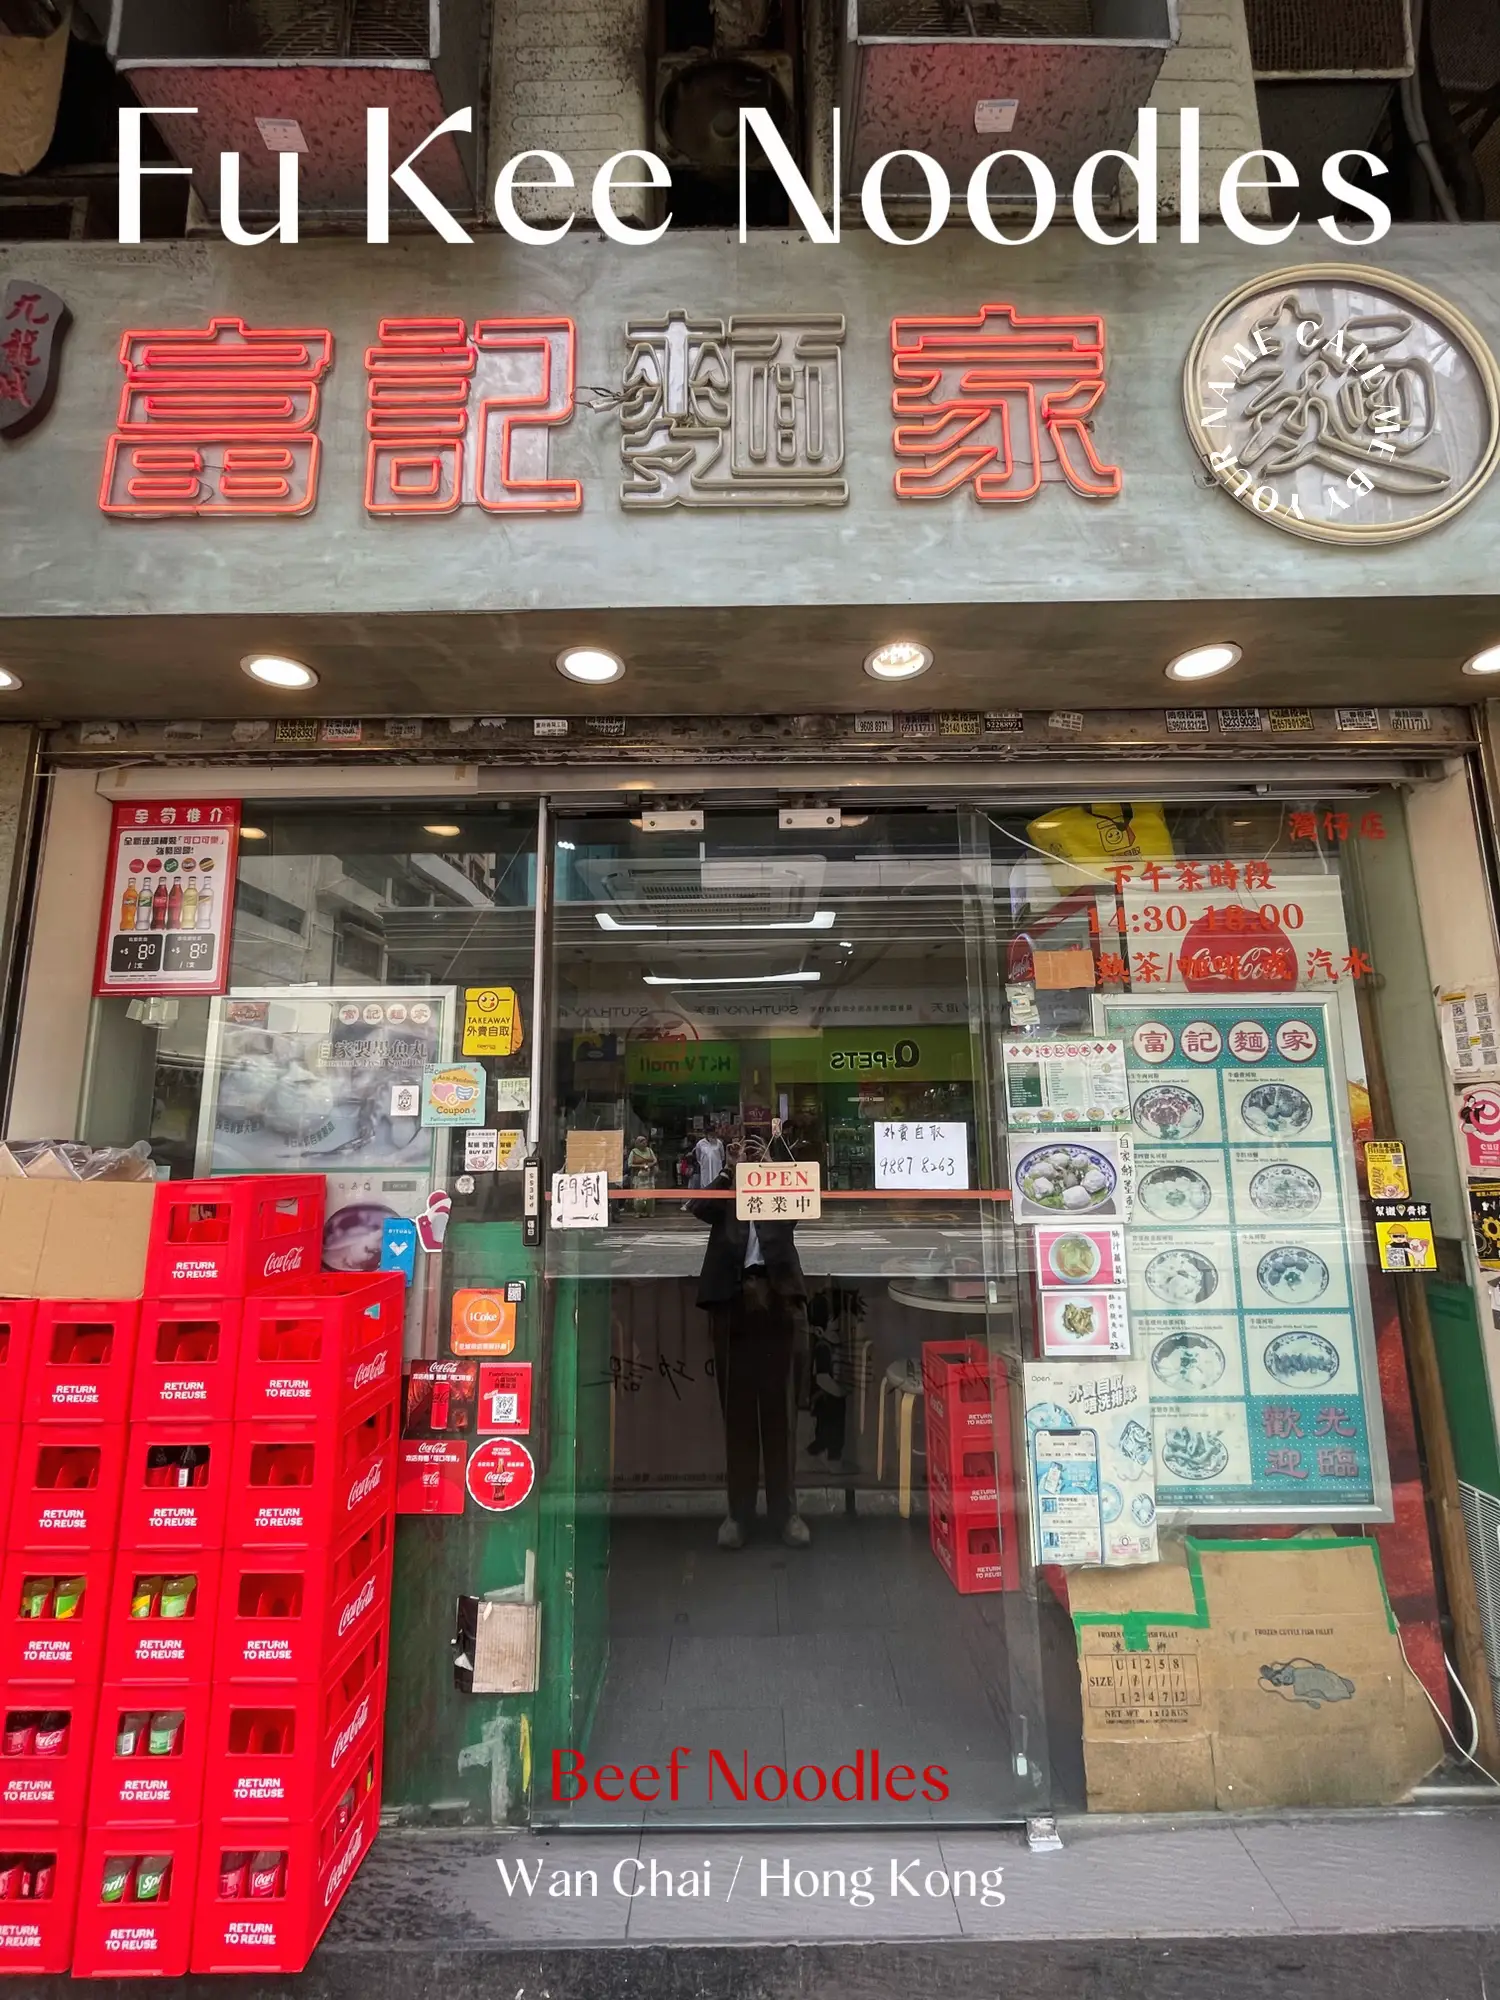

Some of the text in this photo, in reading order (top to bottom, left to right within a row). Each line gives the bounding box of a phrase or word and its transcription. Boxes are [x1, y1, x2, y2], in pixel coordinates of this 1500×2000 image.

[1288, 811, 1387, 841] 灣仔店
[1104, 860, 1277, 894] 下午茶時段
[1306, 947, 1374, 981] 汽水
[467, 1017, 511, 1025] TAKEAWAY
[466, 1026, 510, 1037] 外賣自取
[1139, 1029, 1310, 1054] 富記麵家
[436, 1105, 471, 1117] Coupon
[882, 1123, 946, 1141] 外賣自取
[878, 1155, 956, 1178] 9887 8263
[747, 1169, 810, 1187] OPEN
[746, 1194, 812, 1214] 營業中
[175, 1261, 216, 1270] RETURN
[171, 1269, 219, 1279] TO REUSE
[56, 1384, 97, 1393] RETURN
[163, 1381, 204, 1390] RETURN
[270, 1379, 309, 1388] RETURN
[160, 1391, 207, 1400] TO REUSE
[265, 1389, 312, 1397] TO REUSE
[51, 1394, 99, 1403] TO REUSE
[43, 1509, 84, 1518] RETURN
[153, 1508, 194, 1517] RETURN
[258, 1508, 300, 1517] RETURN
[38, 1519, 87, 1528] TO REUSE
[149, 1518, 198, 1527] TO REUSE
[254, 1518, 303, 1527] TO REUSE
[1254, 1628, 1278, 1636] FROZEN
[28, 1640, 70, 1650] RETURN
[139, 1640, 182, 1649] RETURN
[247, 1640, 289, 1649] RETURN
[23, 1651, 73, 1661] TO REUSE
[135, 1650, 185, 1659] TO REUSE
[243, 1650, 292, 1660] TO REUSE
[1115, 1659, 1180, 1670] U 1 2 5 8
[1089, 1677, 1114, 1687] SIZE
[1121, 1692, 1186, 1703] 1 2 4 7 12
[7, 1780, 53, 1790] RETURN
[124, 1780, 168, 1790] RETURN
[238, 1777, 281, 1787] RETURN
[3, 1791, 55, 1801] TO REUSE
[119, 1790, 171, 1801] TO REUSE
[233, 1787, 285, 1798] TO REUSE
[228, 1923, 273, 1933] RETURN
[109, 1928, 154, 1939] RETURN
[9, 1936, 41, 1947] REUSE
[105, 1939, 158, 1950] TO REUSE
[224, 1934, 276, 1945] TO REUSE
